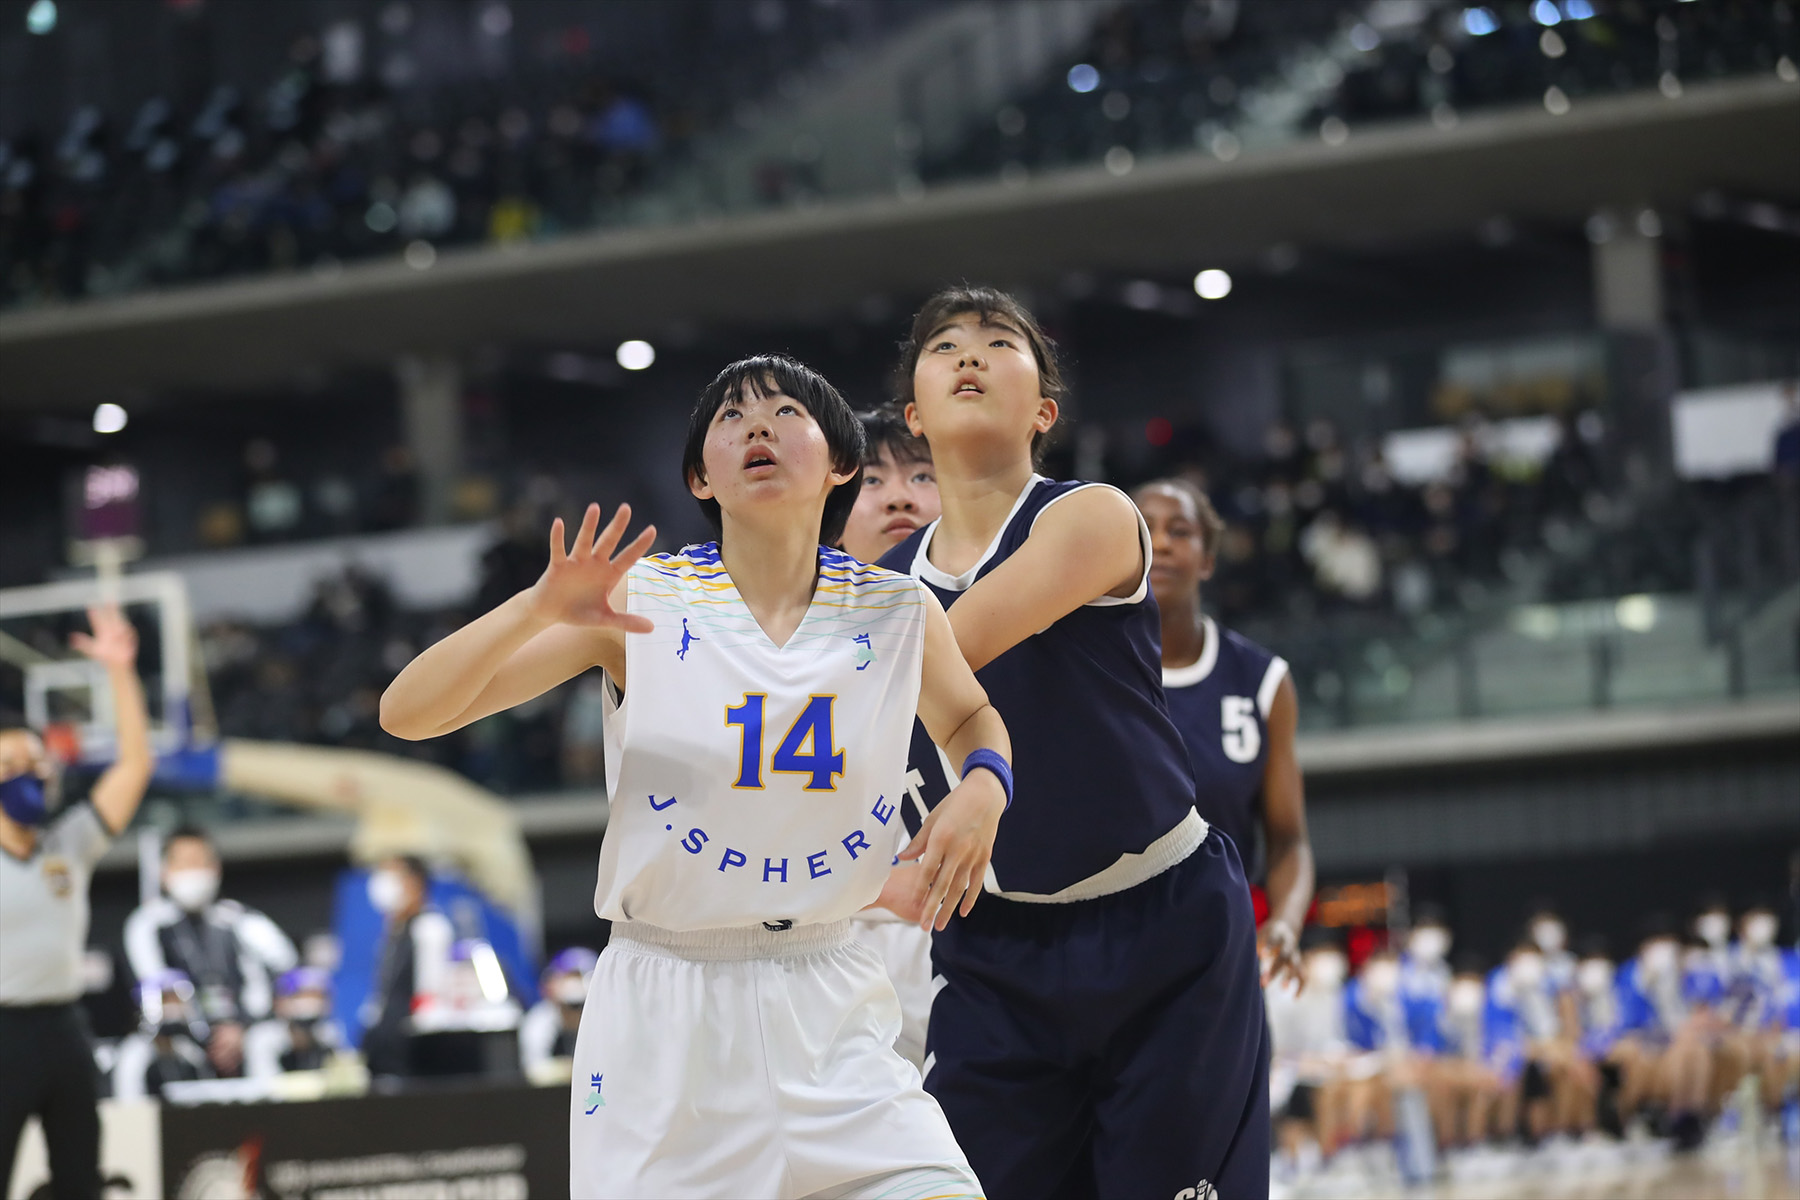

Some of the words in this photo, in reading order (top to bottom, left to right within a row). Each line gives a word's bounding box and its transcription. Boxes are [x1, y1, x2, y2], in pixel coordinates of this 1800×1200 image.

[725, 692, 846, 792] 14
[1221, 695, 1261, 763] 5
[648, 794, 895, 882] J.SPHERE
